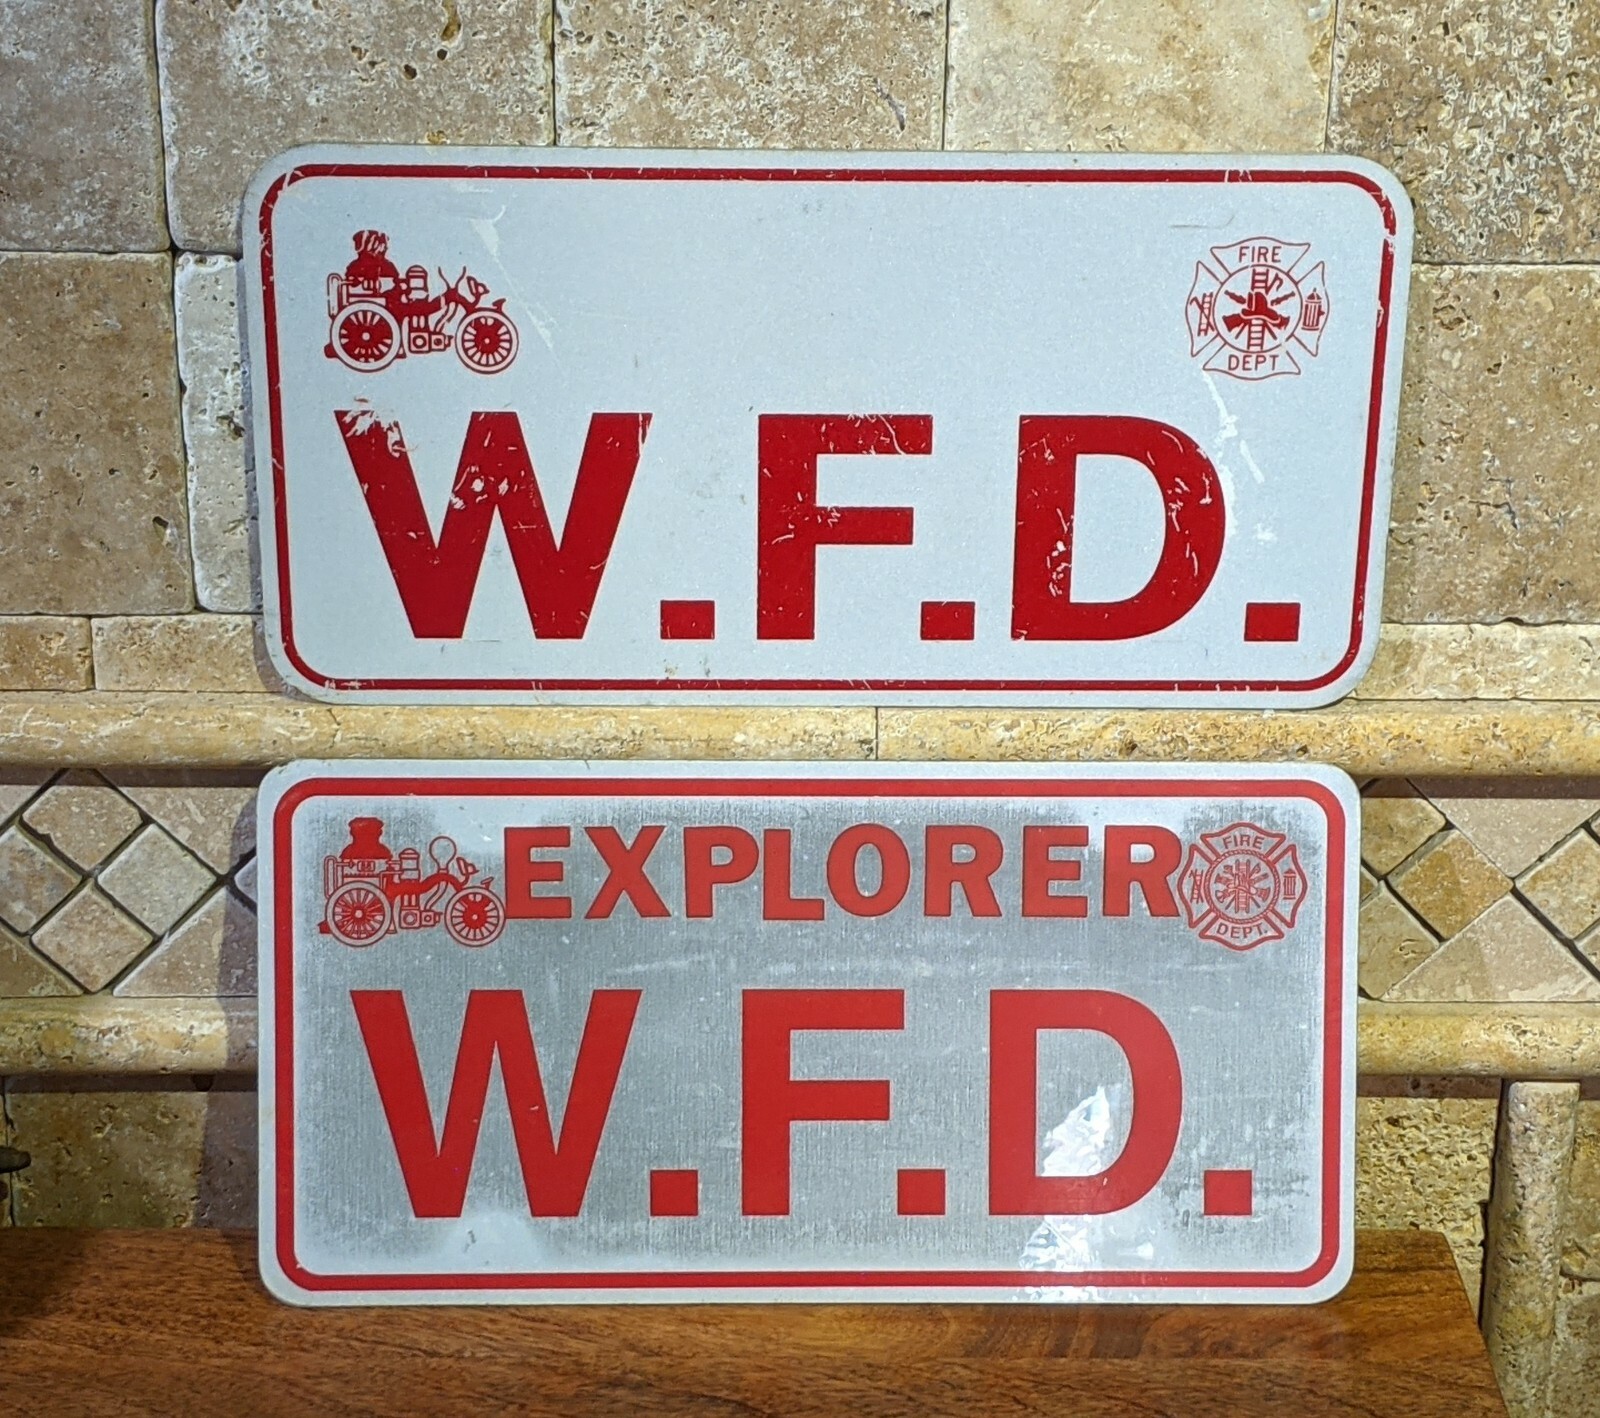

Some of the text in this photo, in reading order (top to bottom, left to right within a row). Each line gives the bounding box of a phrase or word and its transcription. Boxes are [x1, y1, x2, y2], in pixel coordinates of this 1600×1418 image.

[1238, 246, 1282, 263] FIRE
[1228, 354, 1279, 371] DEPT
[334, 410, 1301, 642] W.F.D.
[1222, 834, 1265, 850] FIRE
[504, 823, 1182, 920] EXPLORER
[1216, 922, 1268, 939] DEPT.
[349, 989, 1253, 1218] W.F.D.
